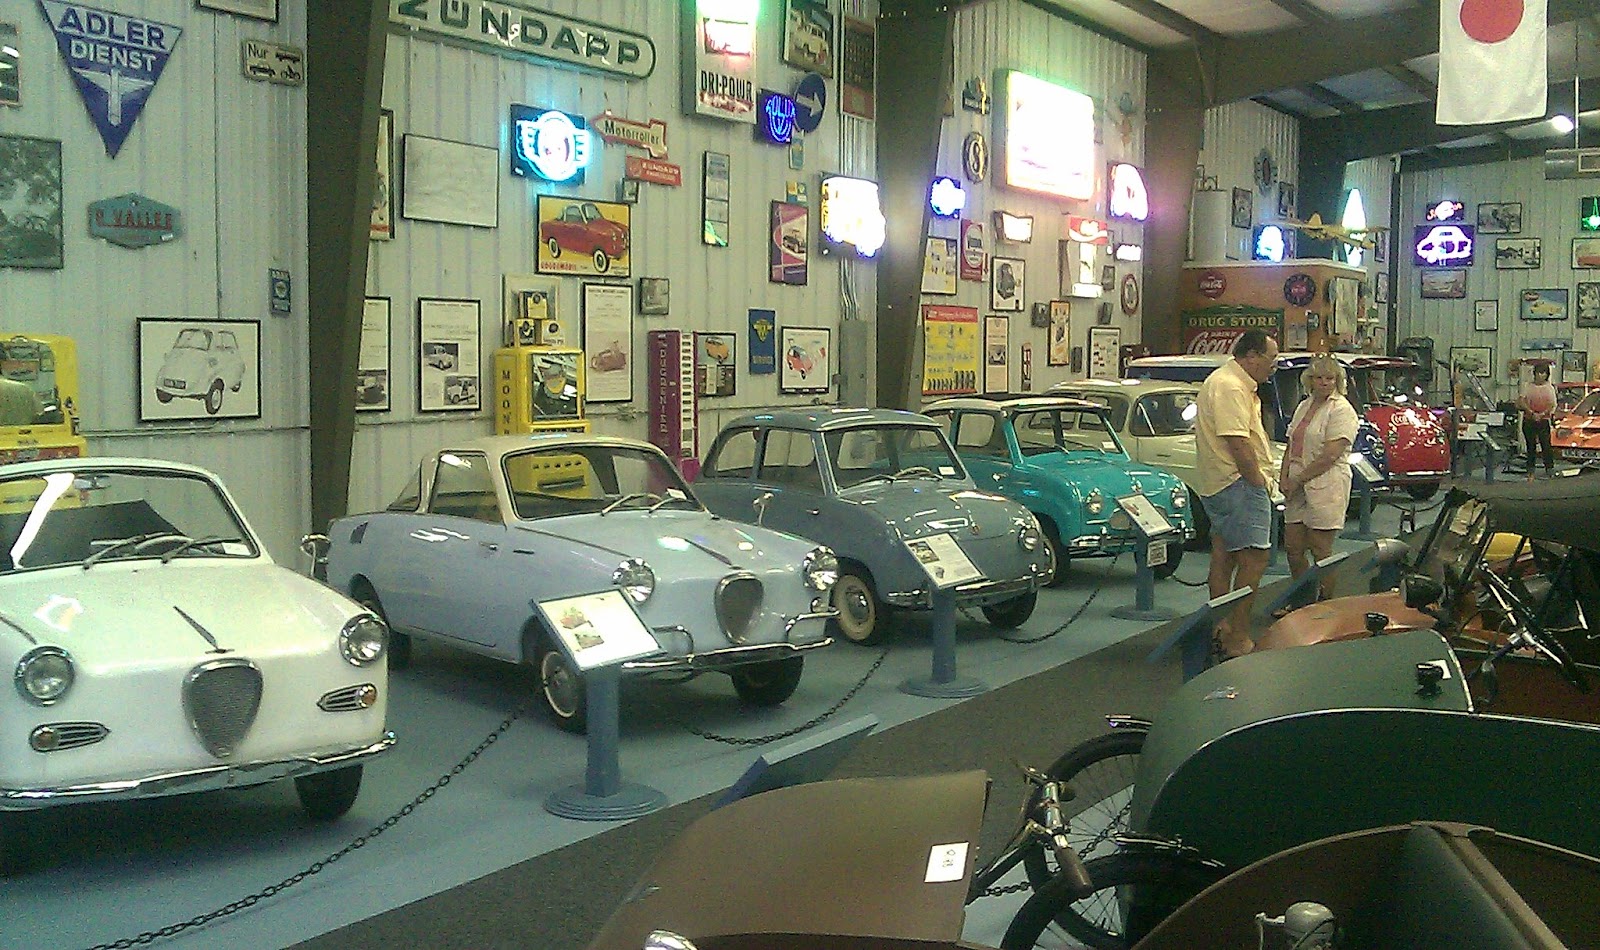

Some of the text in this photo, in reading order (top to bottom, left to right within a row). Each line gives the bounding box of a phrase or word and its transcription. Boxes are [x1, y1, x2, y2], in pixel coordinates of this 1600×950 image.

[58, 6, 166, 50] ADLER
[69, 38, 157, 73] DIENST
[247, 42, 268, 60] Nur
[604, 119, 660, 145] Motorroller
[1188, 316, 1277, 328] DRUG STORE
